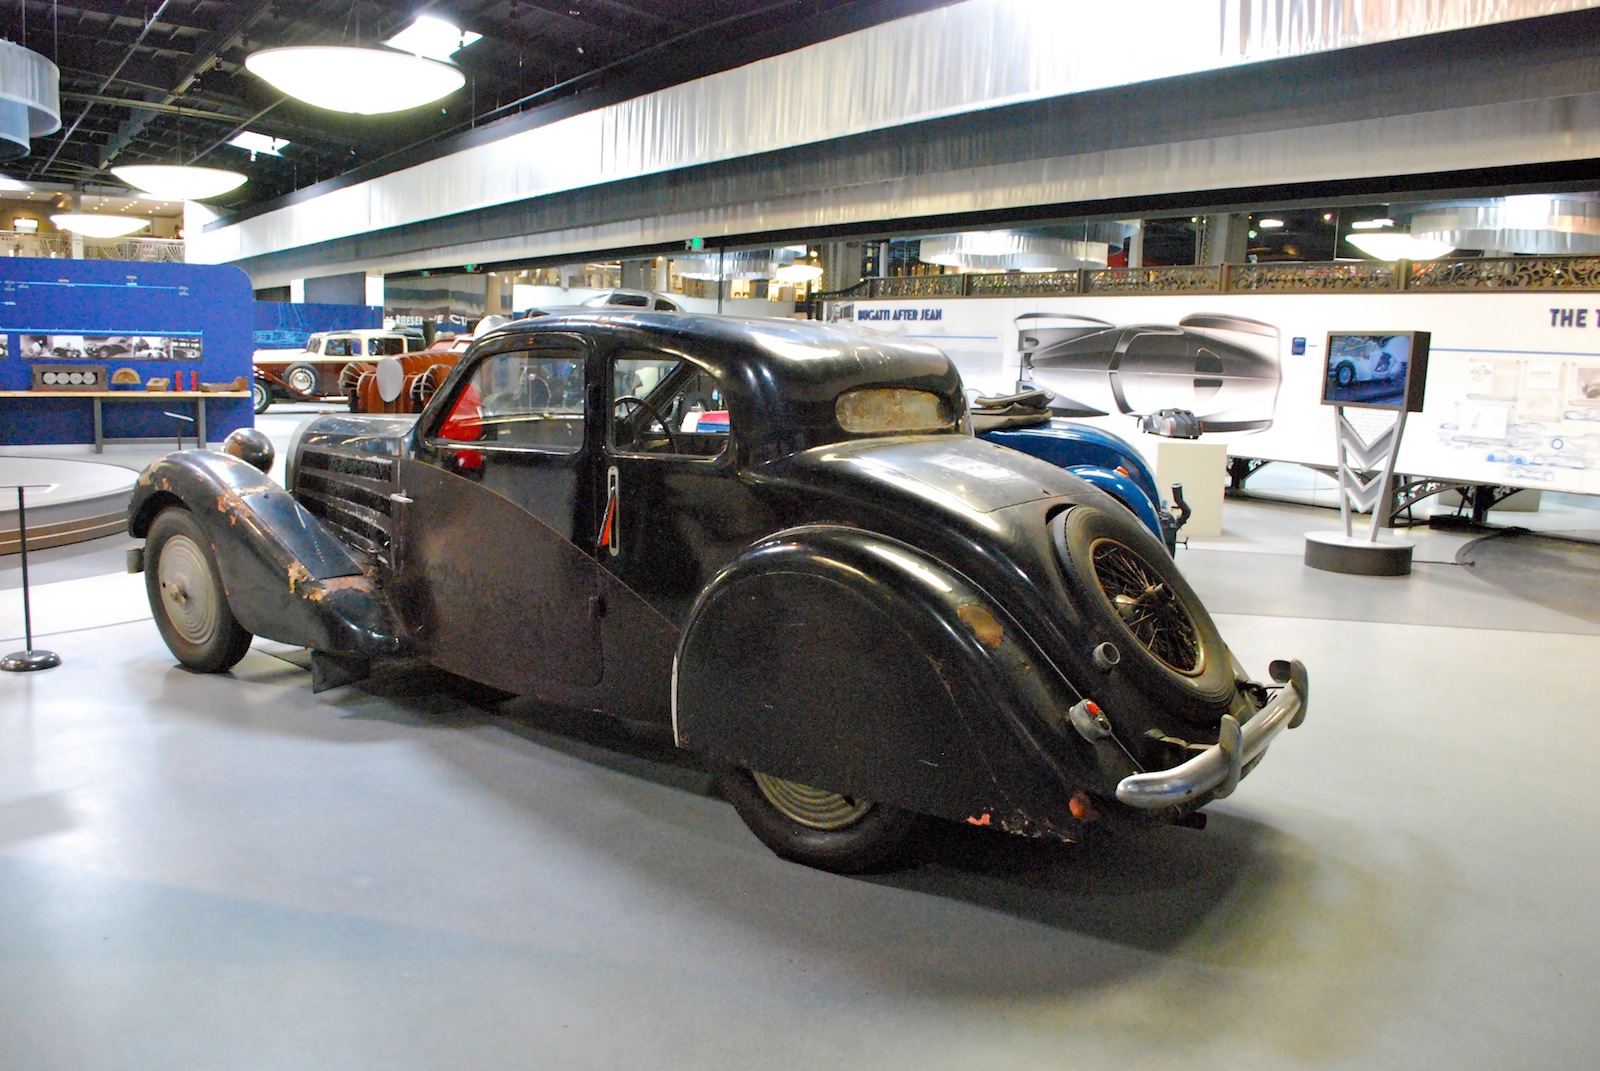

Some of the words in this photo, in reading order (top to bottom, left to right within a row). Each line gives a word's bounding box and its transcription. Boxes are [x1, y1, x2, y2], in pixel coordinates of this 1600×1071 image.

[858, 309, 890, 321] BUGATTI
[892, 309, 918, 321] AFTER
[920, 309, 942, 320] JEAN
[1549, 308, 1588, 328] THE
